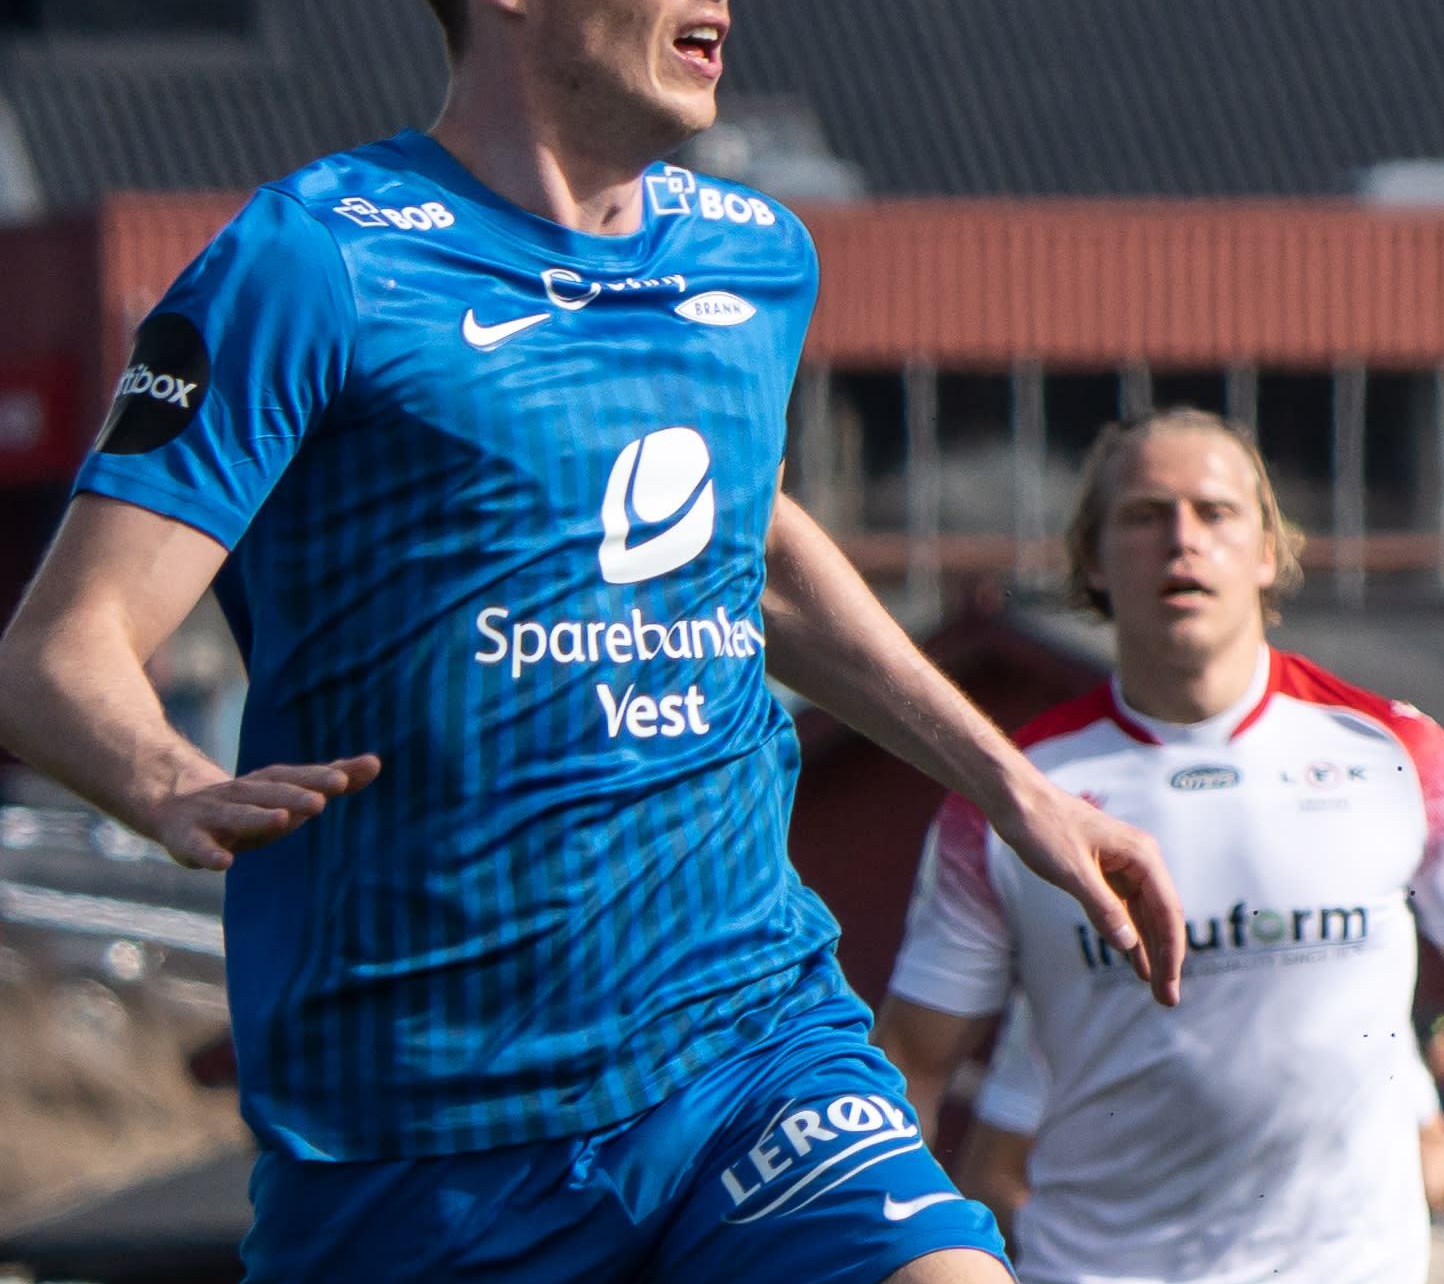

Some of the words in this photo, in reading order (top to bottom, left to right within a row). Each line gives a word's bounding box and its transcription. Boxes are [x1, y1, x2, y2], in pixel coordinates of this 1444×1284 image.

[384, 202, 455, 230] BOB
[699, 188, 776, 225] BOB
[695, 302, 742, 316] BRANN
[474, 605, 766, 679] Sparebanken
[596, 683, 710, 738] Vest
